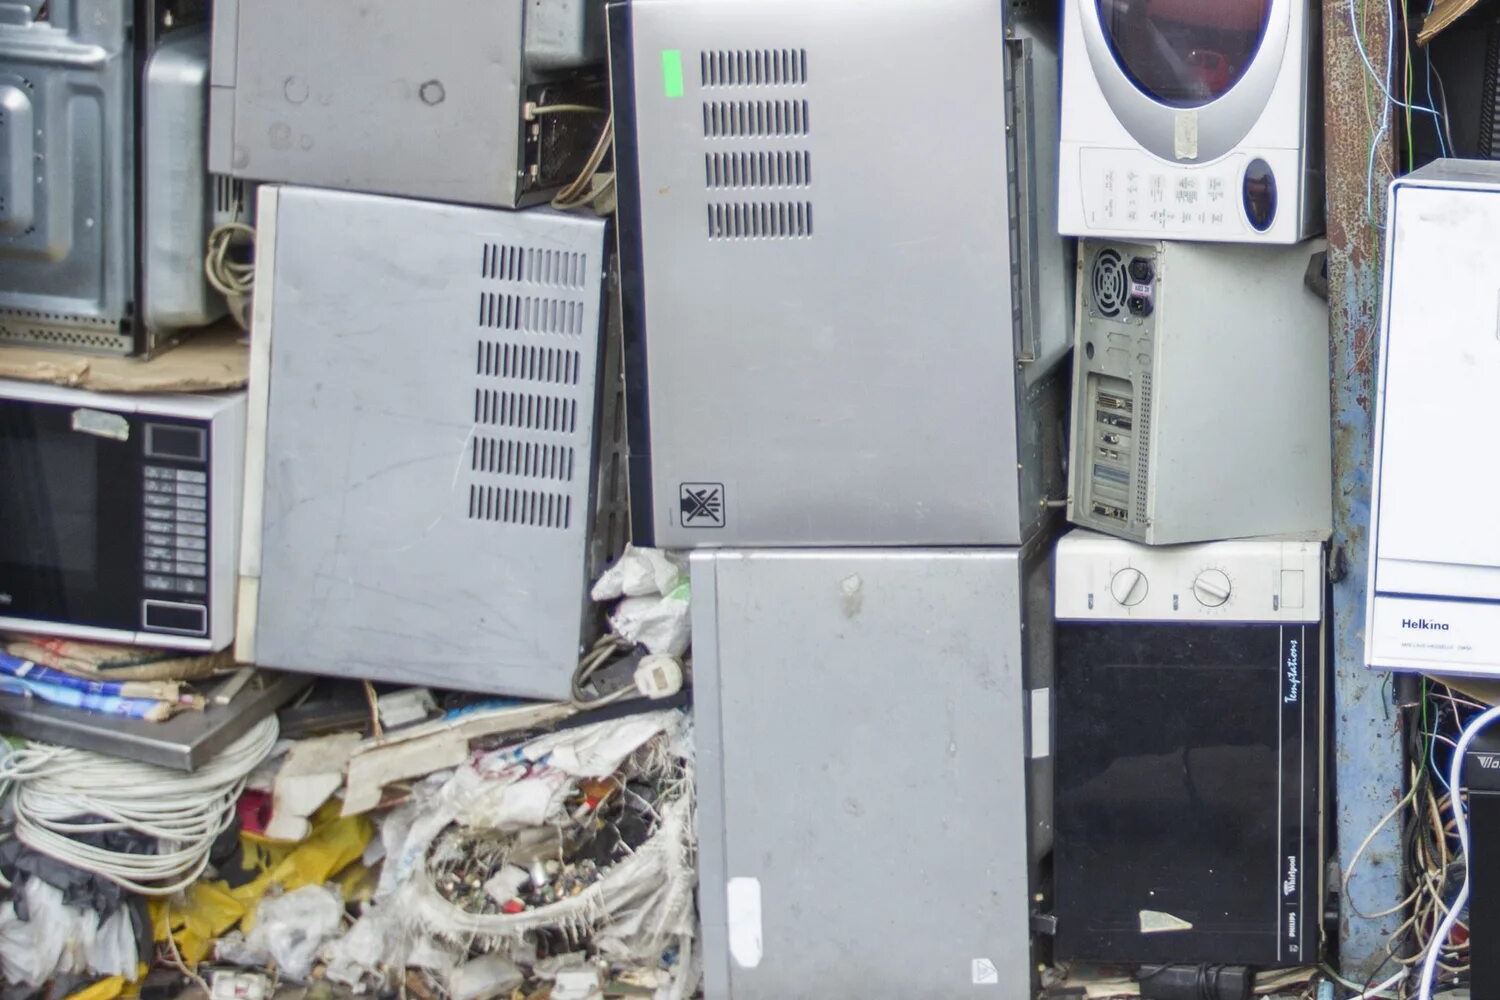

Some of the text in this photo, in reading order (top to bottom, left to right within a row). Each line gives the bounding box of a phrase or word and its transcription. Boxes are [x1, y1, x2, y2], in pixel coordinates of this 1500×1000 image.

[1401, 618, 1450, 631] Helkina
[1284, 639, 1302, 704] Temptations
[1286, 855, 1298, 894] Whirlpool
[1287, 911, 1297, 938] PHILIPS
